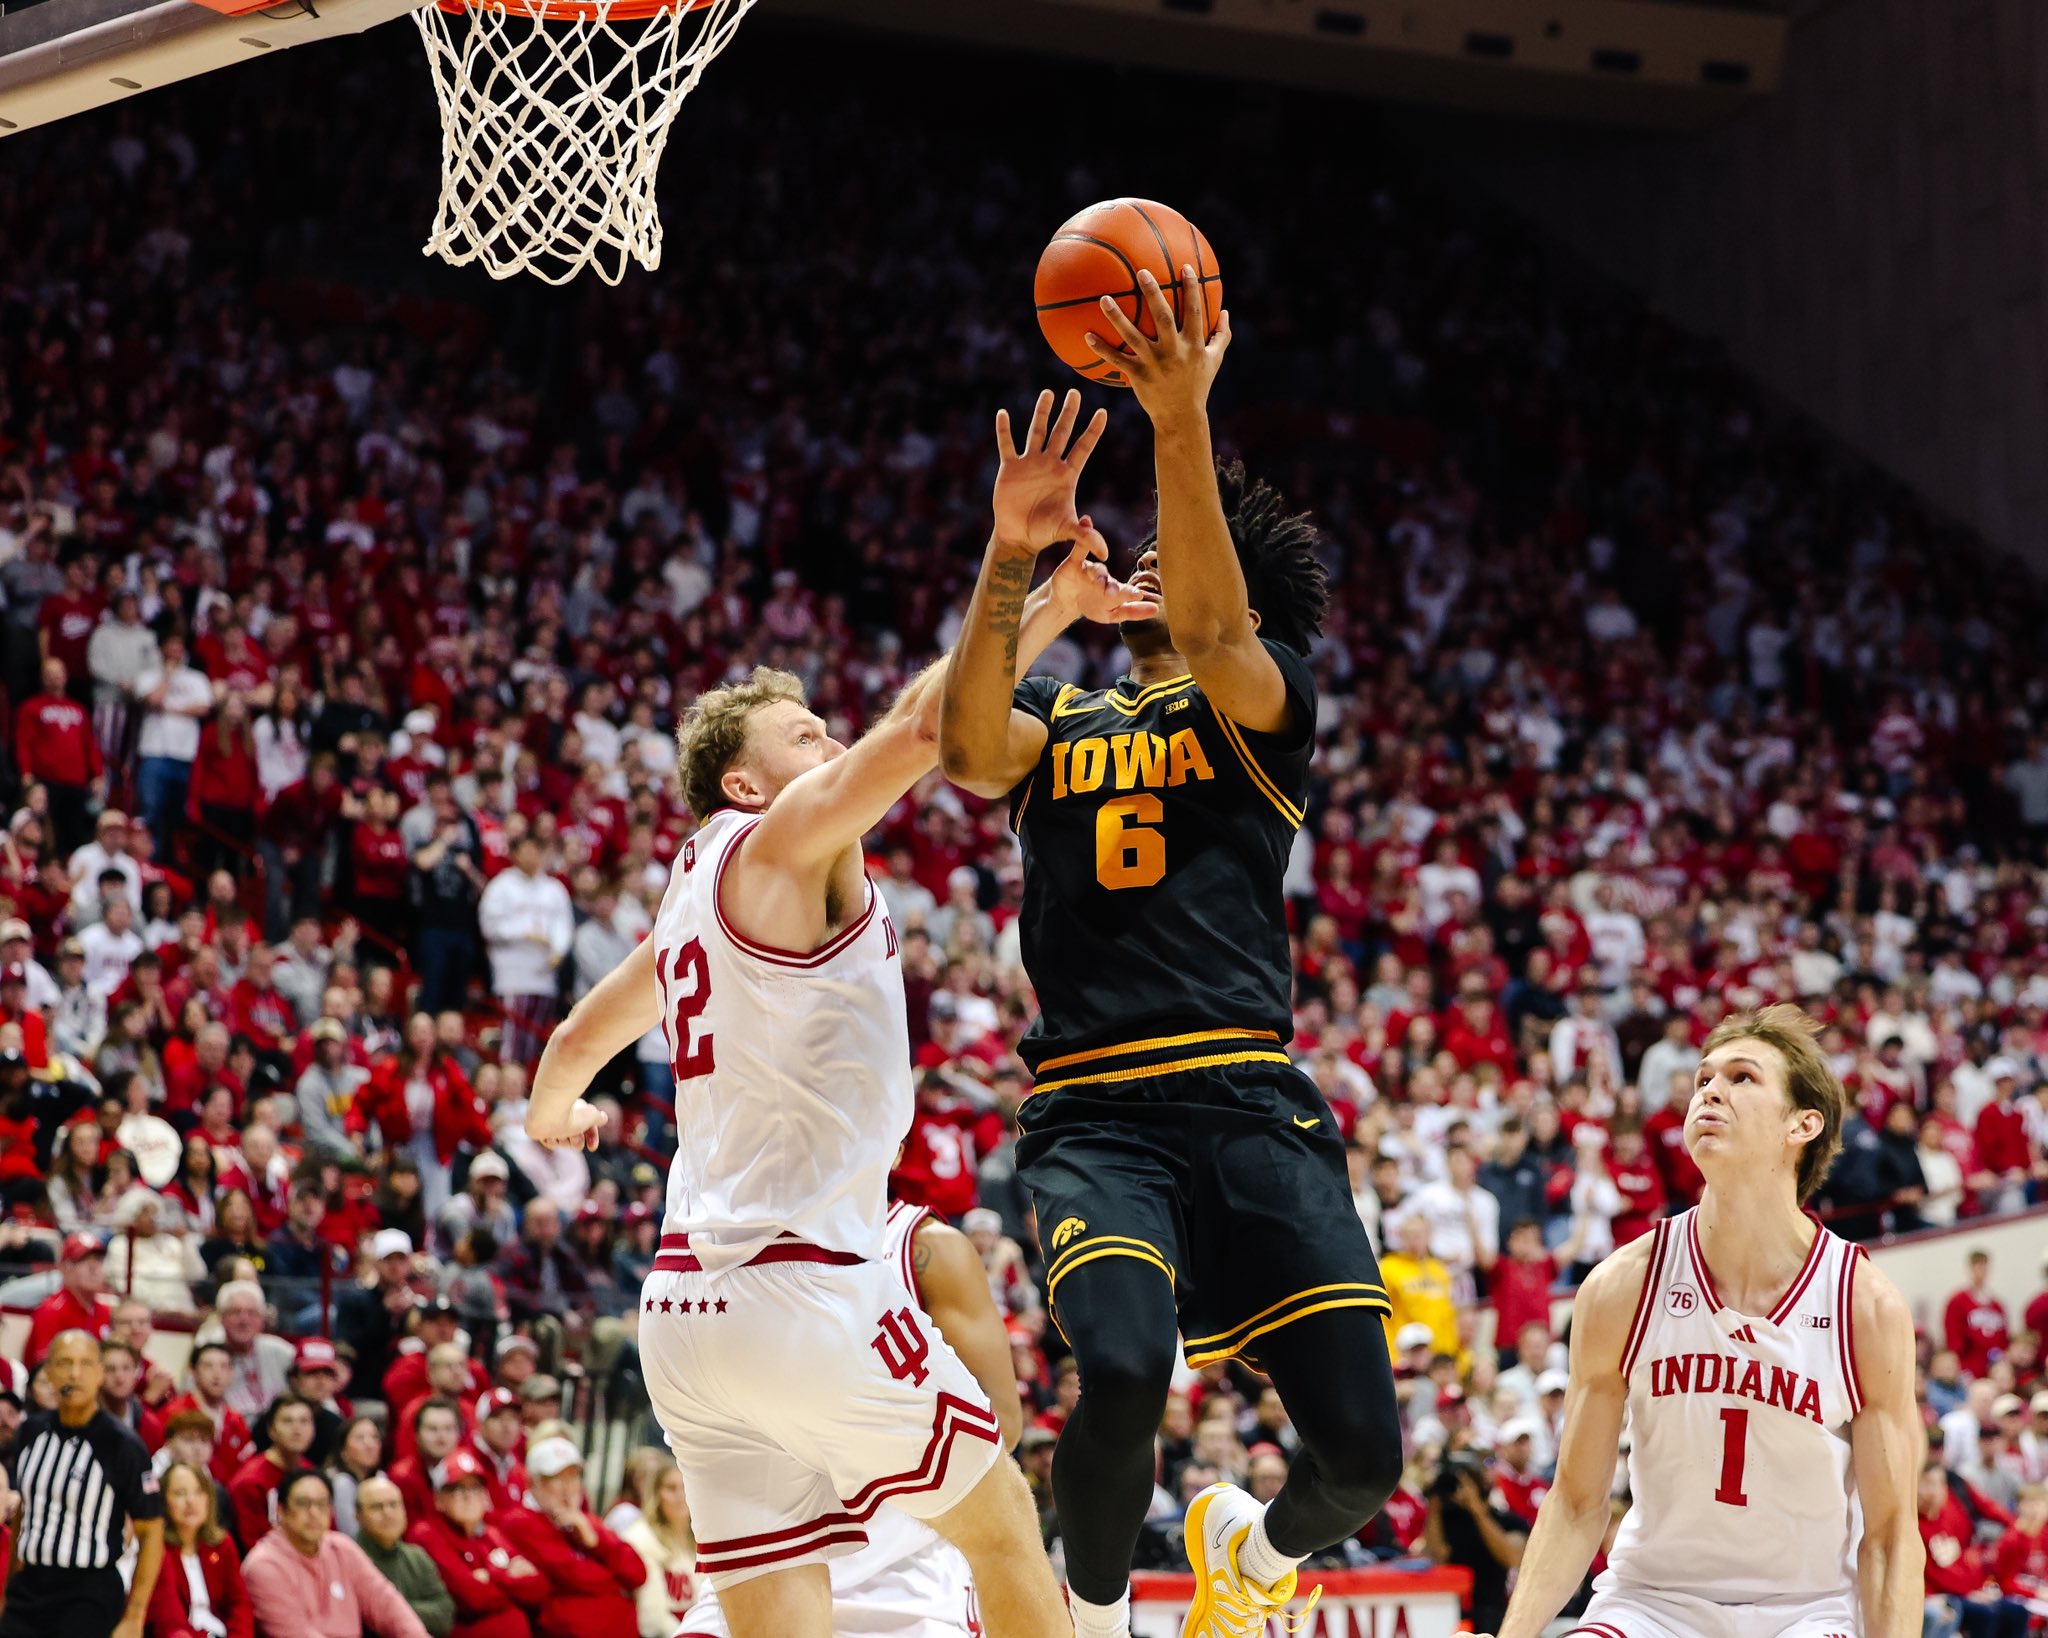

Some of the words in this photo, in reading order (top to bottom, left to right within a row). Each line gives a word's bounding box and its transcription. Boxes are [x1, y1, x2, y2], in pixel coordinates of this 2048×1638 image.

[1052, 727, 1215, 800] IOWA
[1096, 793, 1166, 890] 6
[1651, 1353, 1824, 1425] INDIANA
[1715, 1408, 1748, 1507] 1
